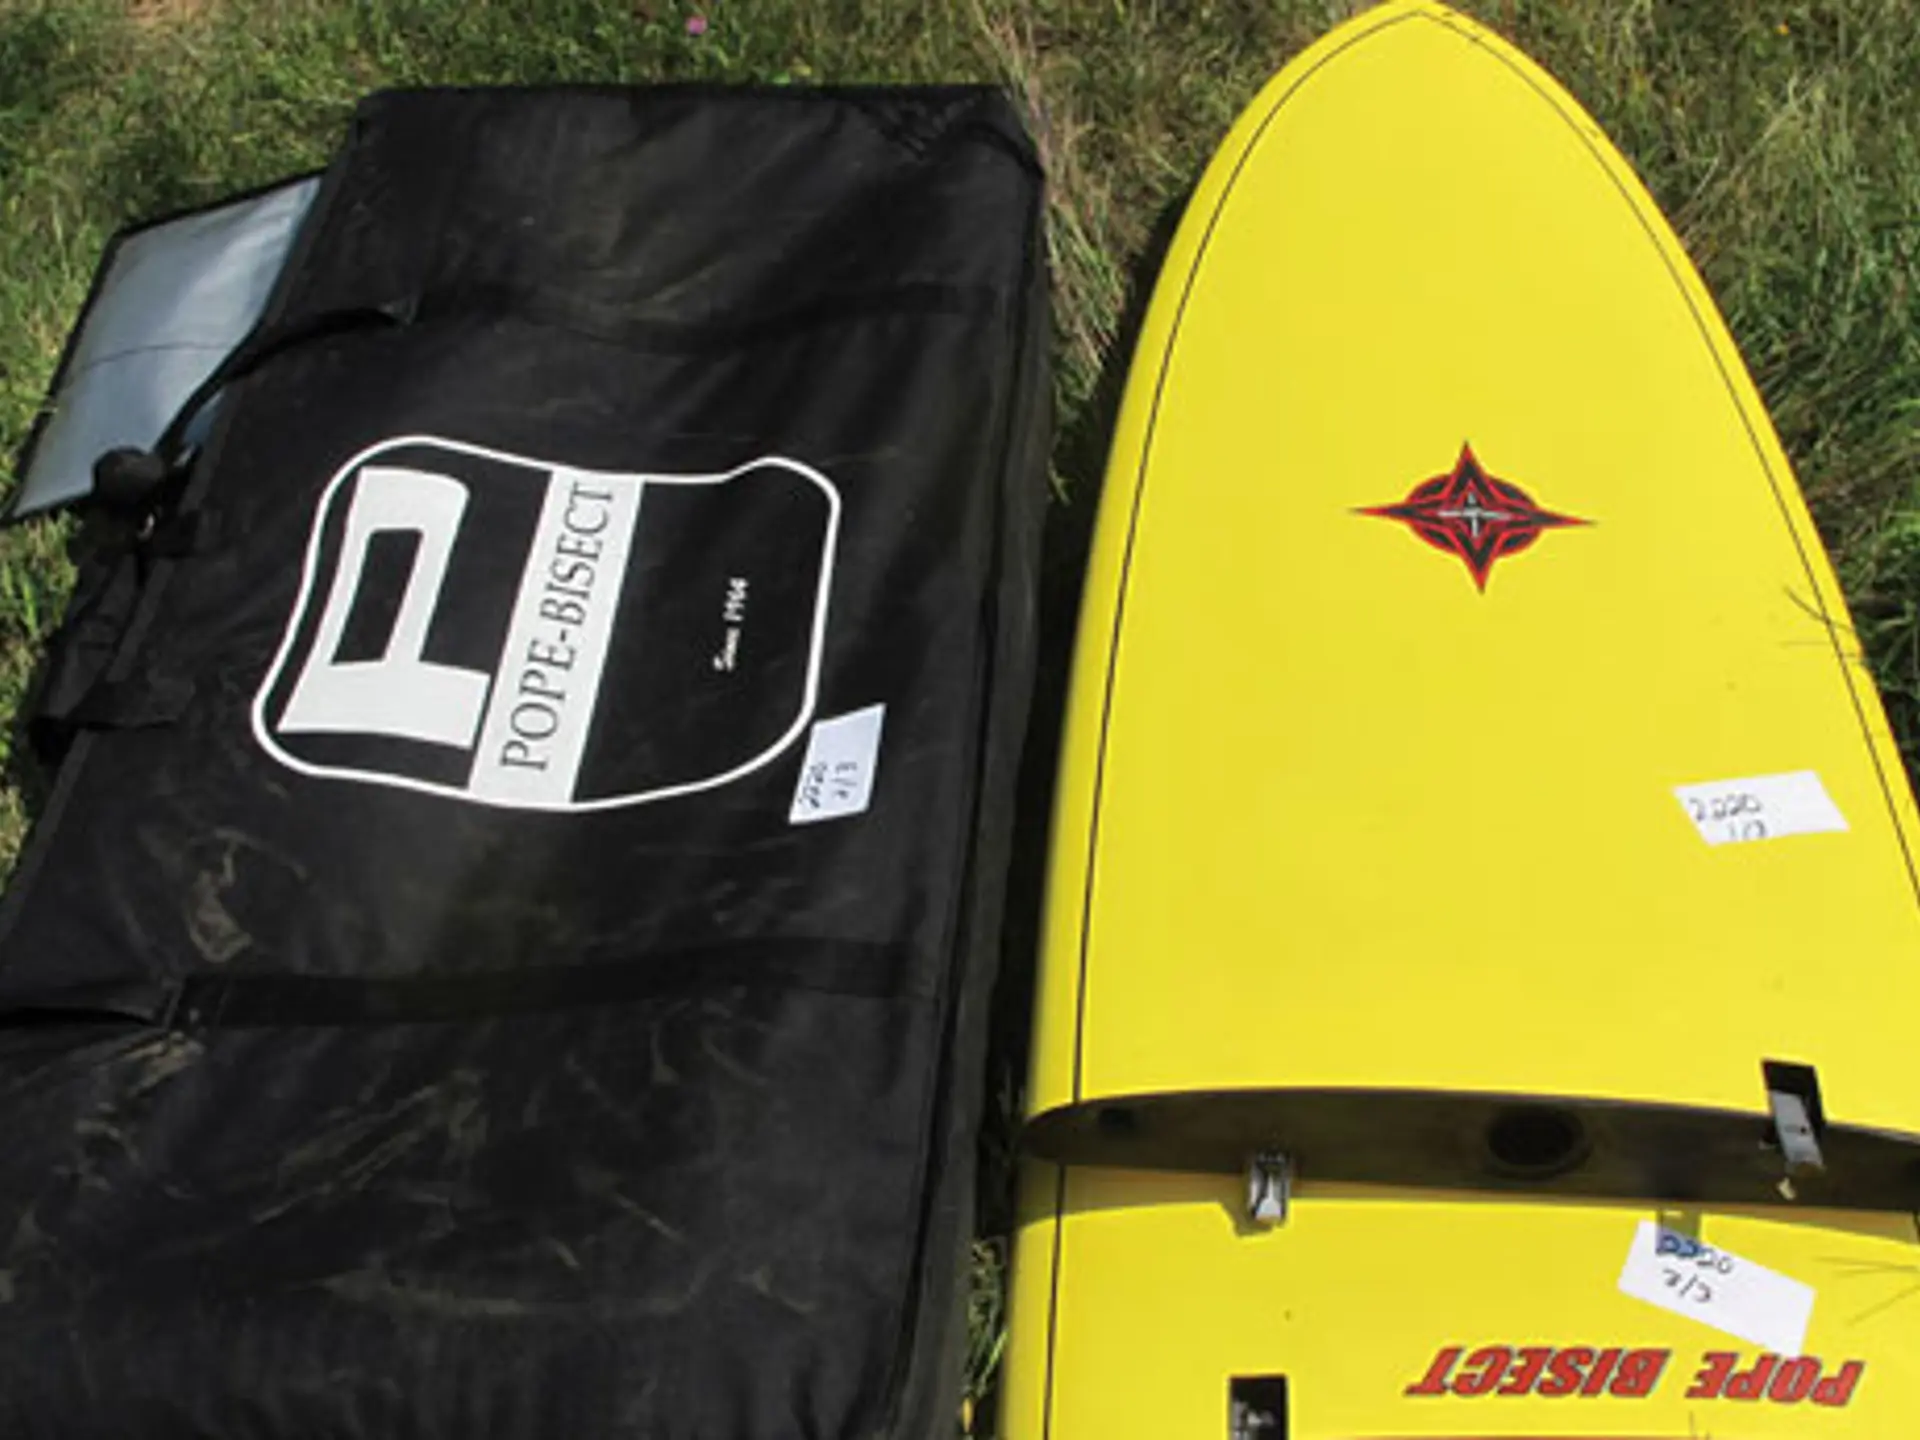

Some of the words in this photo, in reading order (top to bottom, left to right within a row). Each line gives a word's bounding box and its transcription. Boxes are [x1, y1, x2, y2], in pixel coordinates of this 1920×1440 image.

[277, 466, 491, 750] P
[500, 482, 614, 771] POPE-BISECT
[1403, 1345, 1671, 1397] BISECT
[1685, 1352, 1864, 1407] POPE
